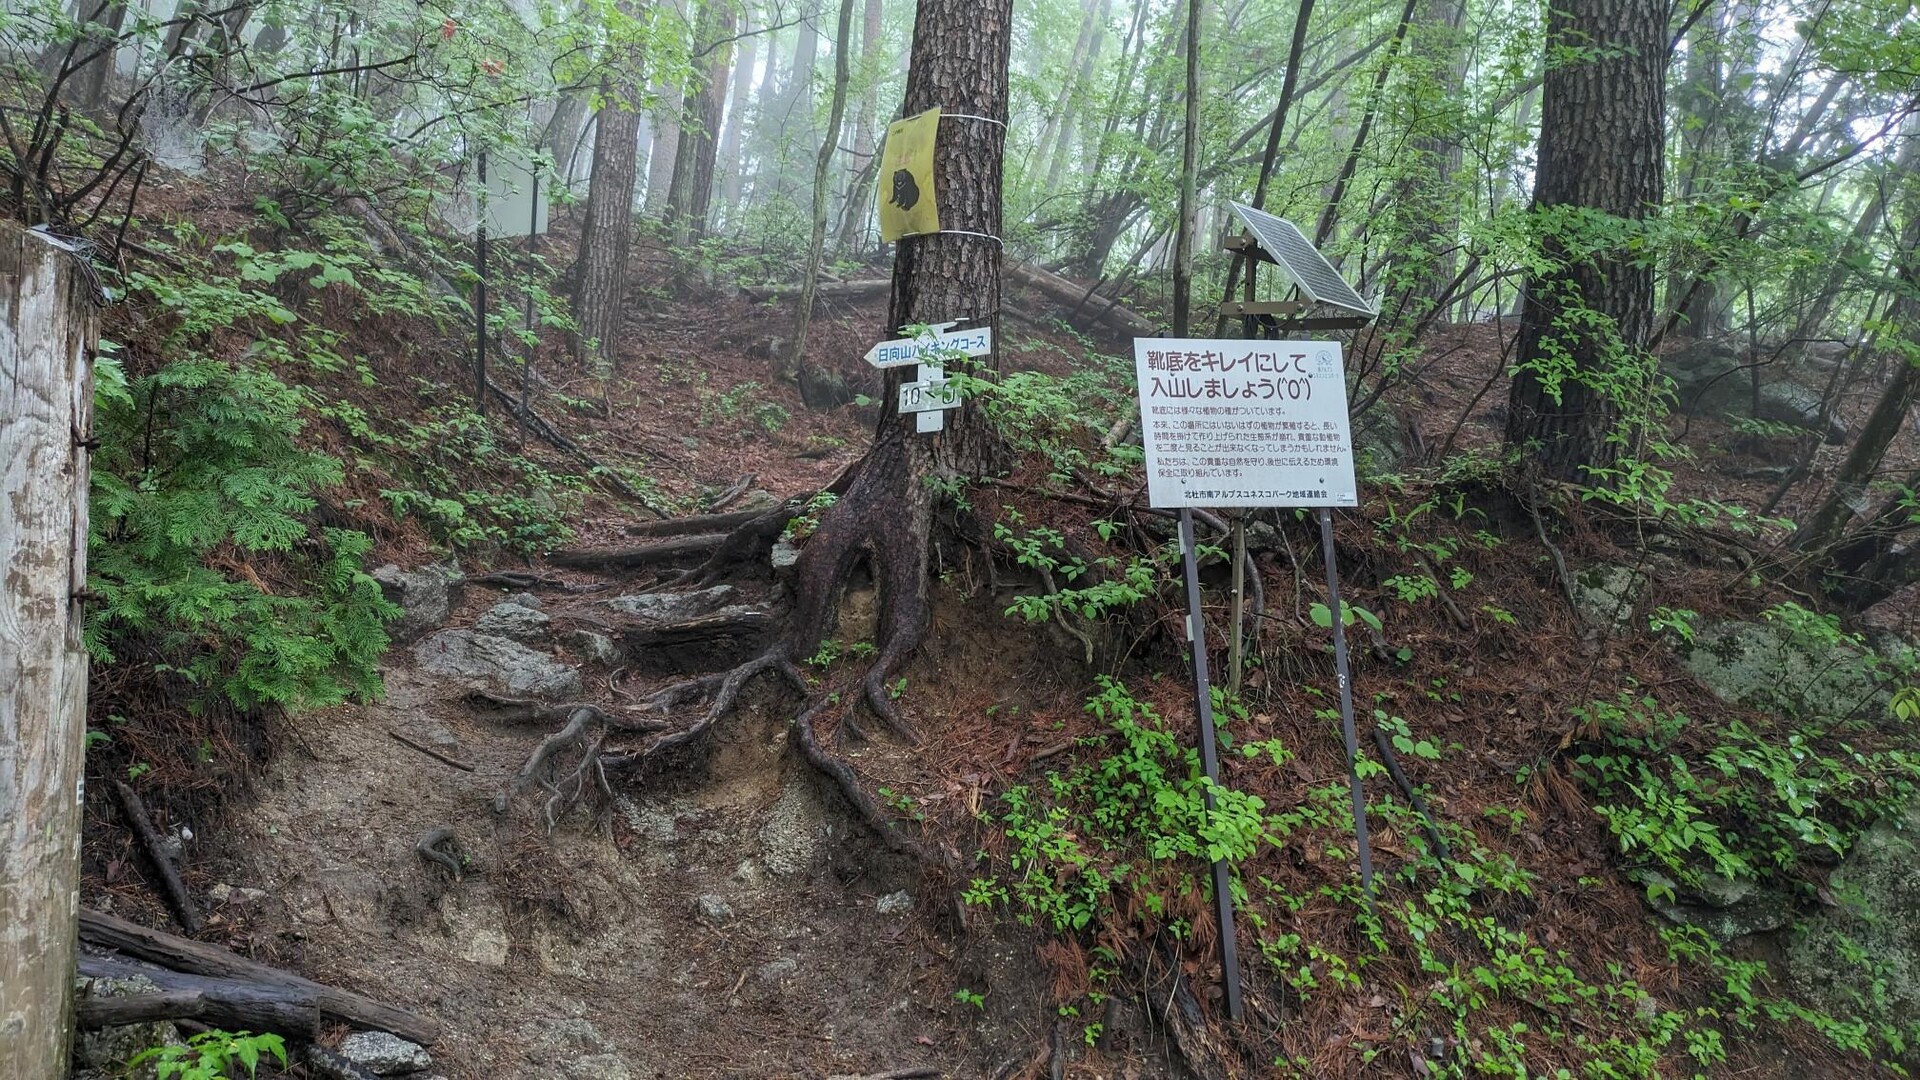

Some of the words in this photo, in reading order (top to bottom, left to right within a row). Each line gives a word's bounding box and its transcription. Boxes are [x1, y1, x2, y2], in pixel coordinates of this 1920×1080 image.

[1147, 350, 1307, 373] 靴底をキレイにして
